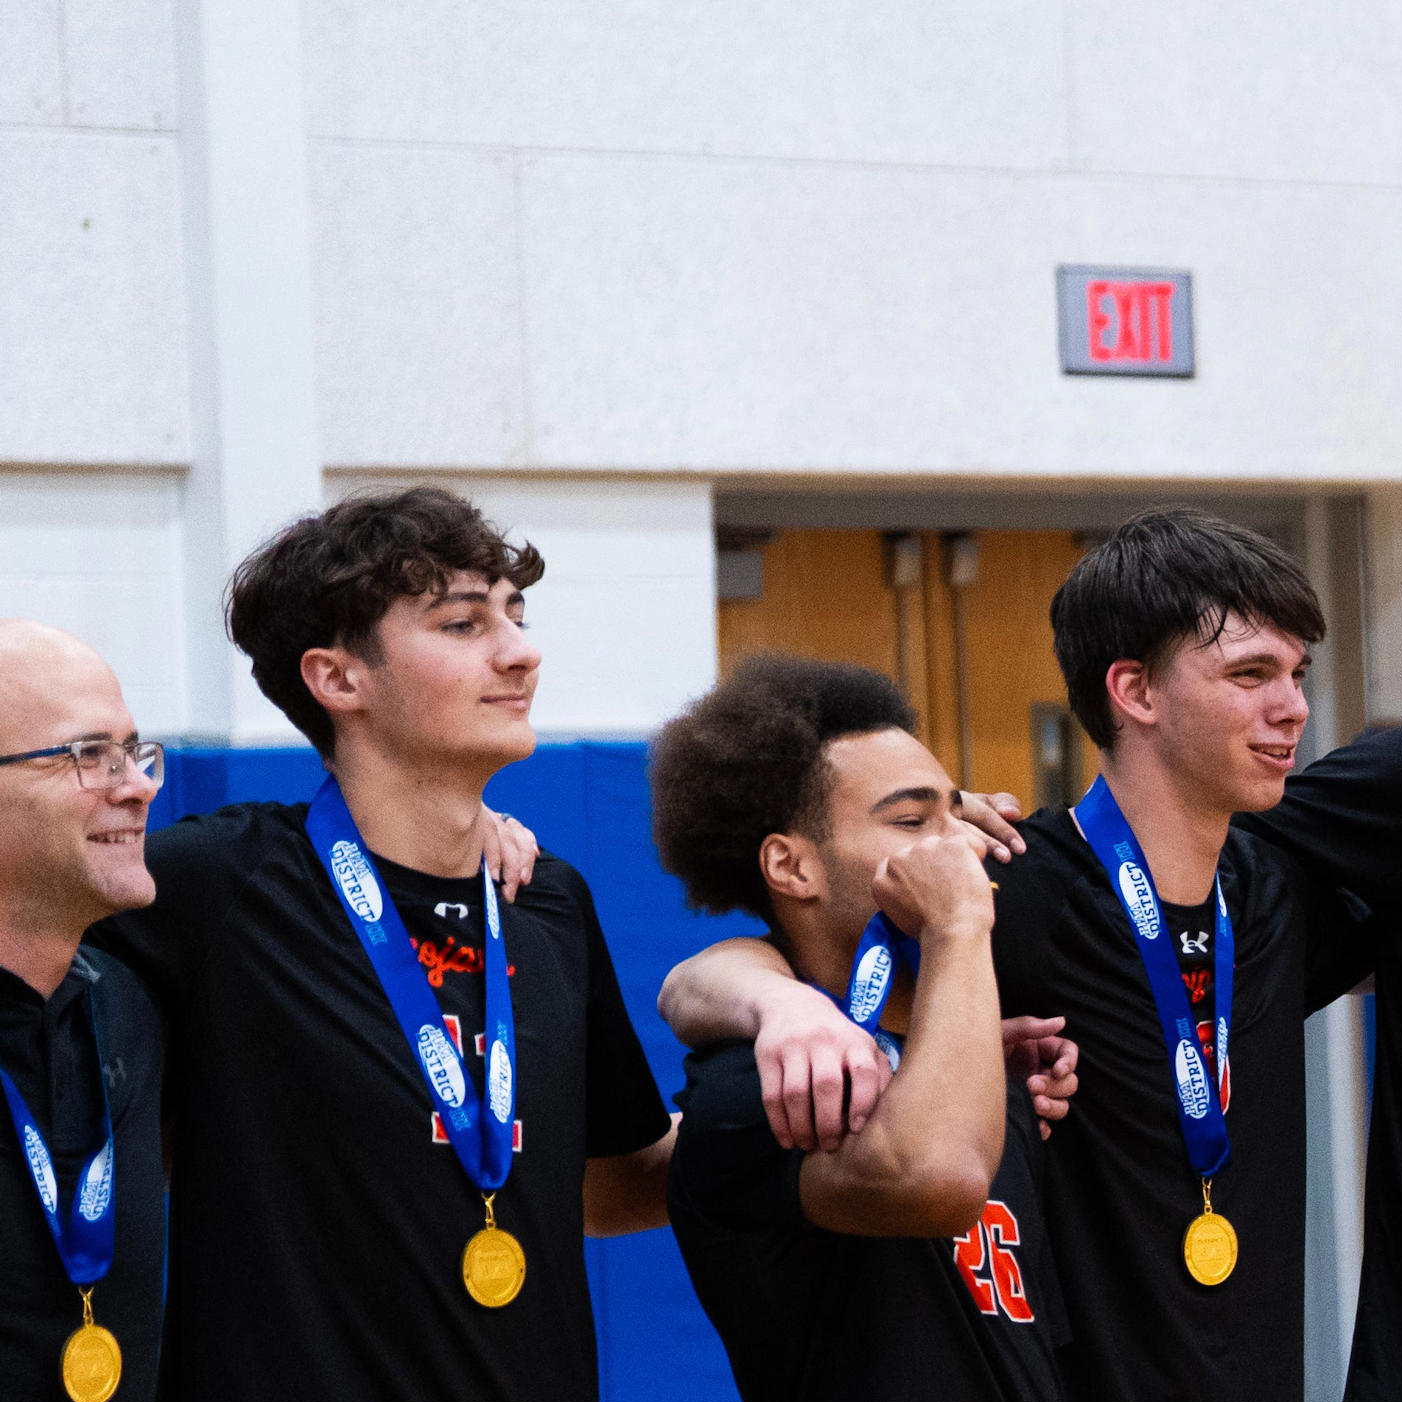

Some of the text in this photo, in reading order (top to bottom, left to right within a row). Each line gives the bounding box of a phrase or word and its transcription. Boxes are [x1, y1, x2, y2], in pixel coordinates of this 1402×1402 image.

[1087, 279, 1175, 362] EXIT
[330, 846, 376, 922] DISTRICT
[1125, 862, 1161, 939] DISTRICT
[861, 947, 893, 1019] DISTRICT
[416, 1031, 459, 1108] DISTRICT
[1182, 1038, 1210, 1118] DISTRICT
[953, 1199, 1035, 1324] 26
